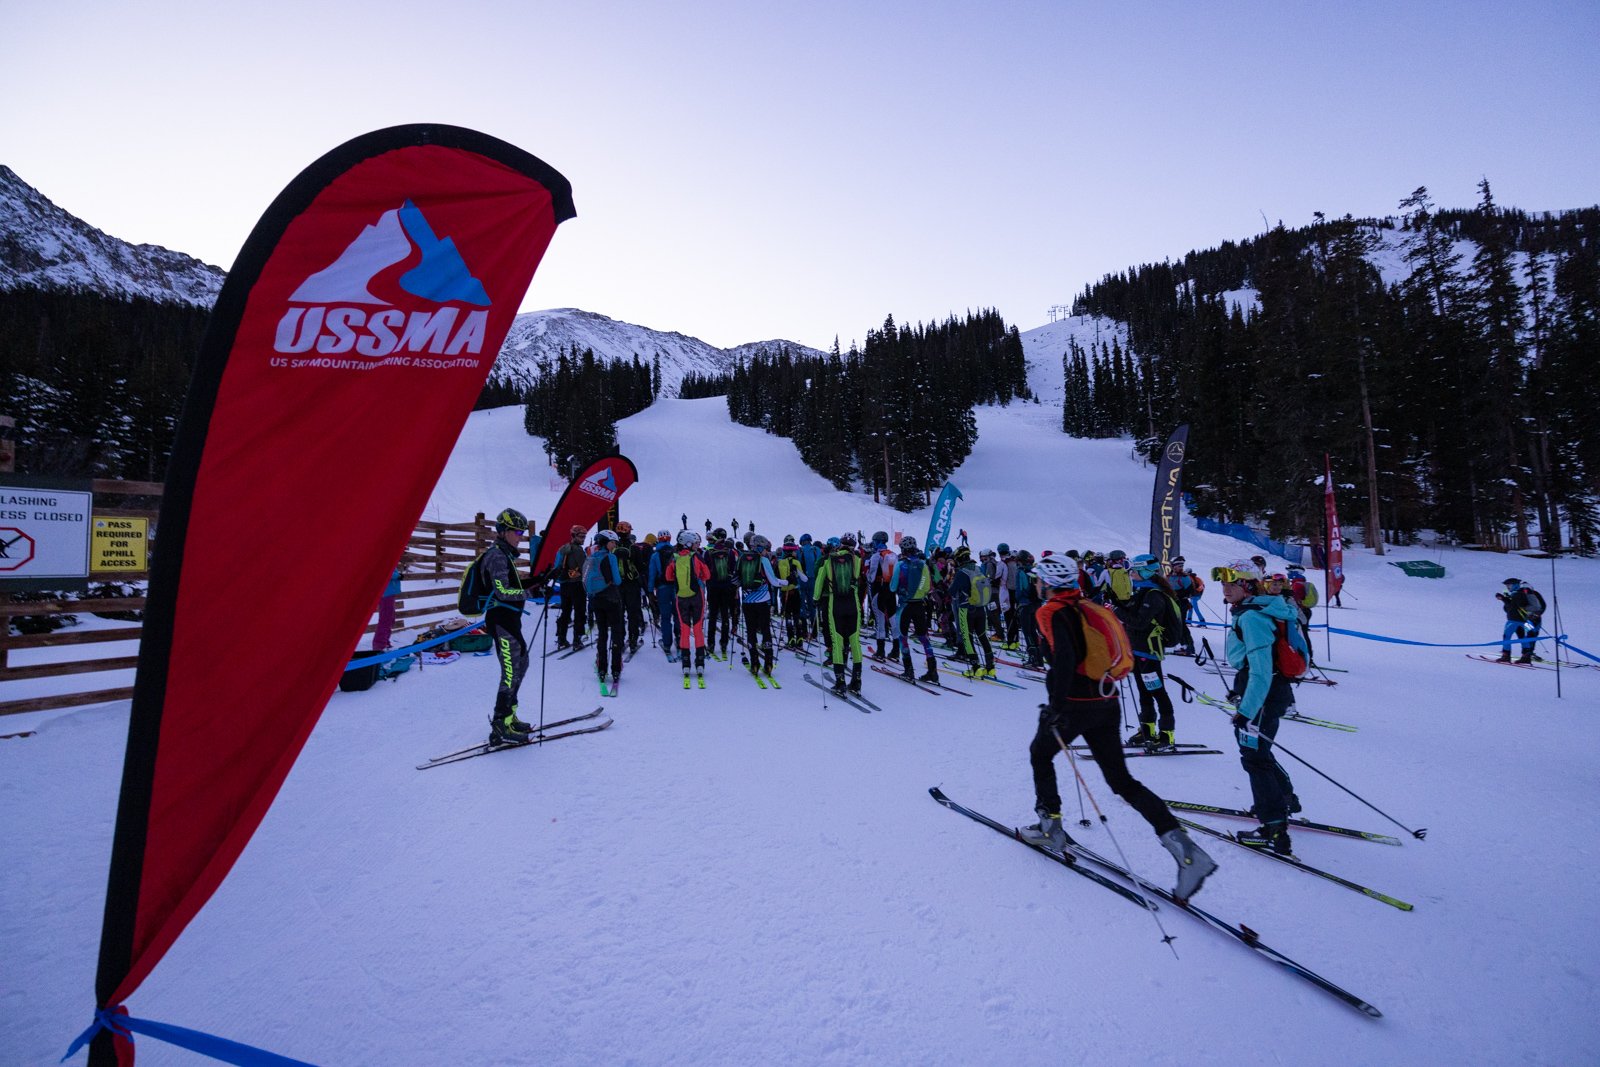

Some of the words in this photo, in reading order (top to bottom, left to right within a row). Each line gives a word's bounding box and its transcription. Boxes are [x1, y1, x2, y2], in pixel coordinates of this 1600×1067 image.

[273, 306, 489, 357] USSMA
[270, 357, 288, 367] US
[412, 357, 479, 369] ASSOCIATION
[578, 480, 616, 501] USSMA
[34, 511, 83, 522] CLOSED
[108, 521, 132, 529] PASS
[933, 499, 952, 546] ARPA
[96, 530, 143, 539] REQUIRED
[110, 540, 128, 548] FOR
[100, 559, 137, 567] ACCESS
